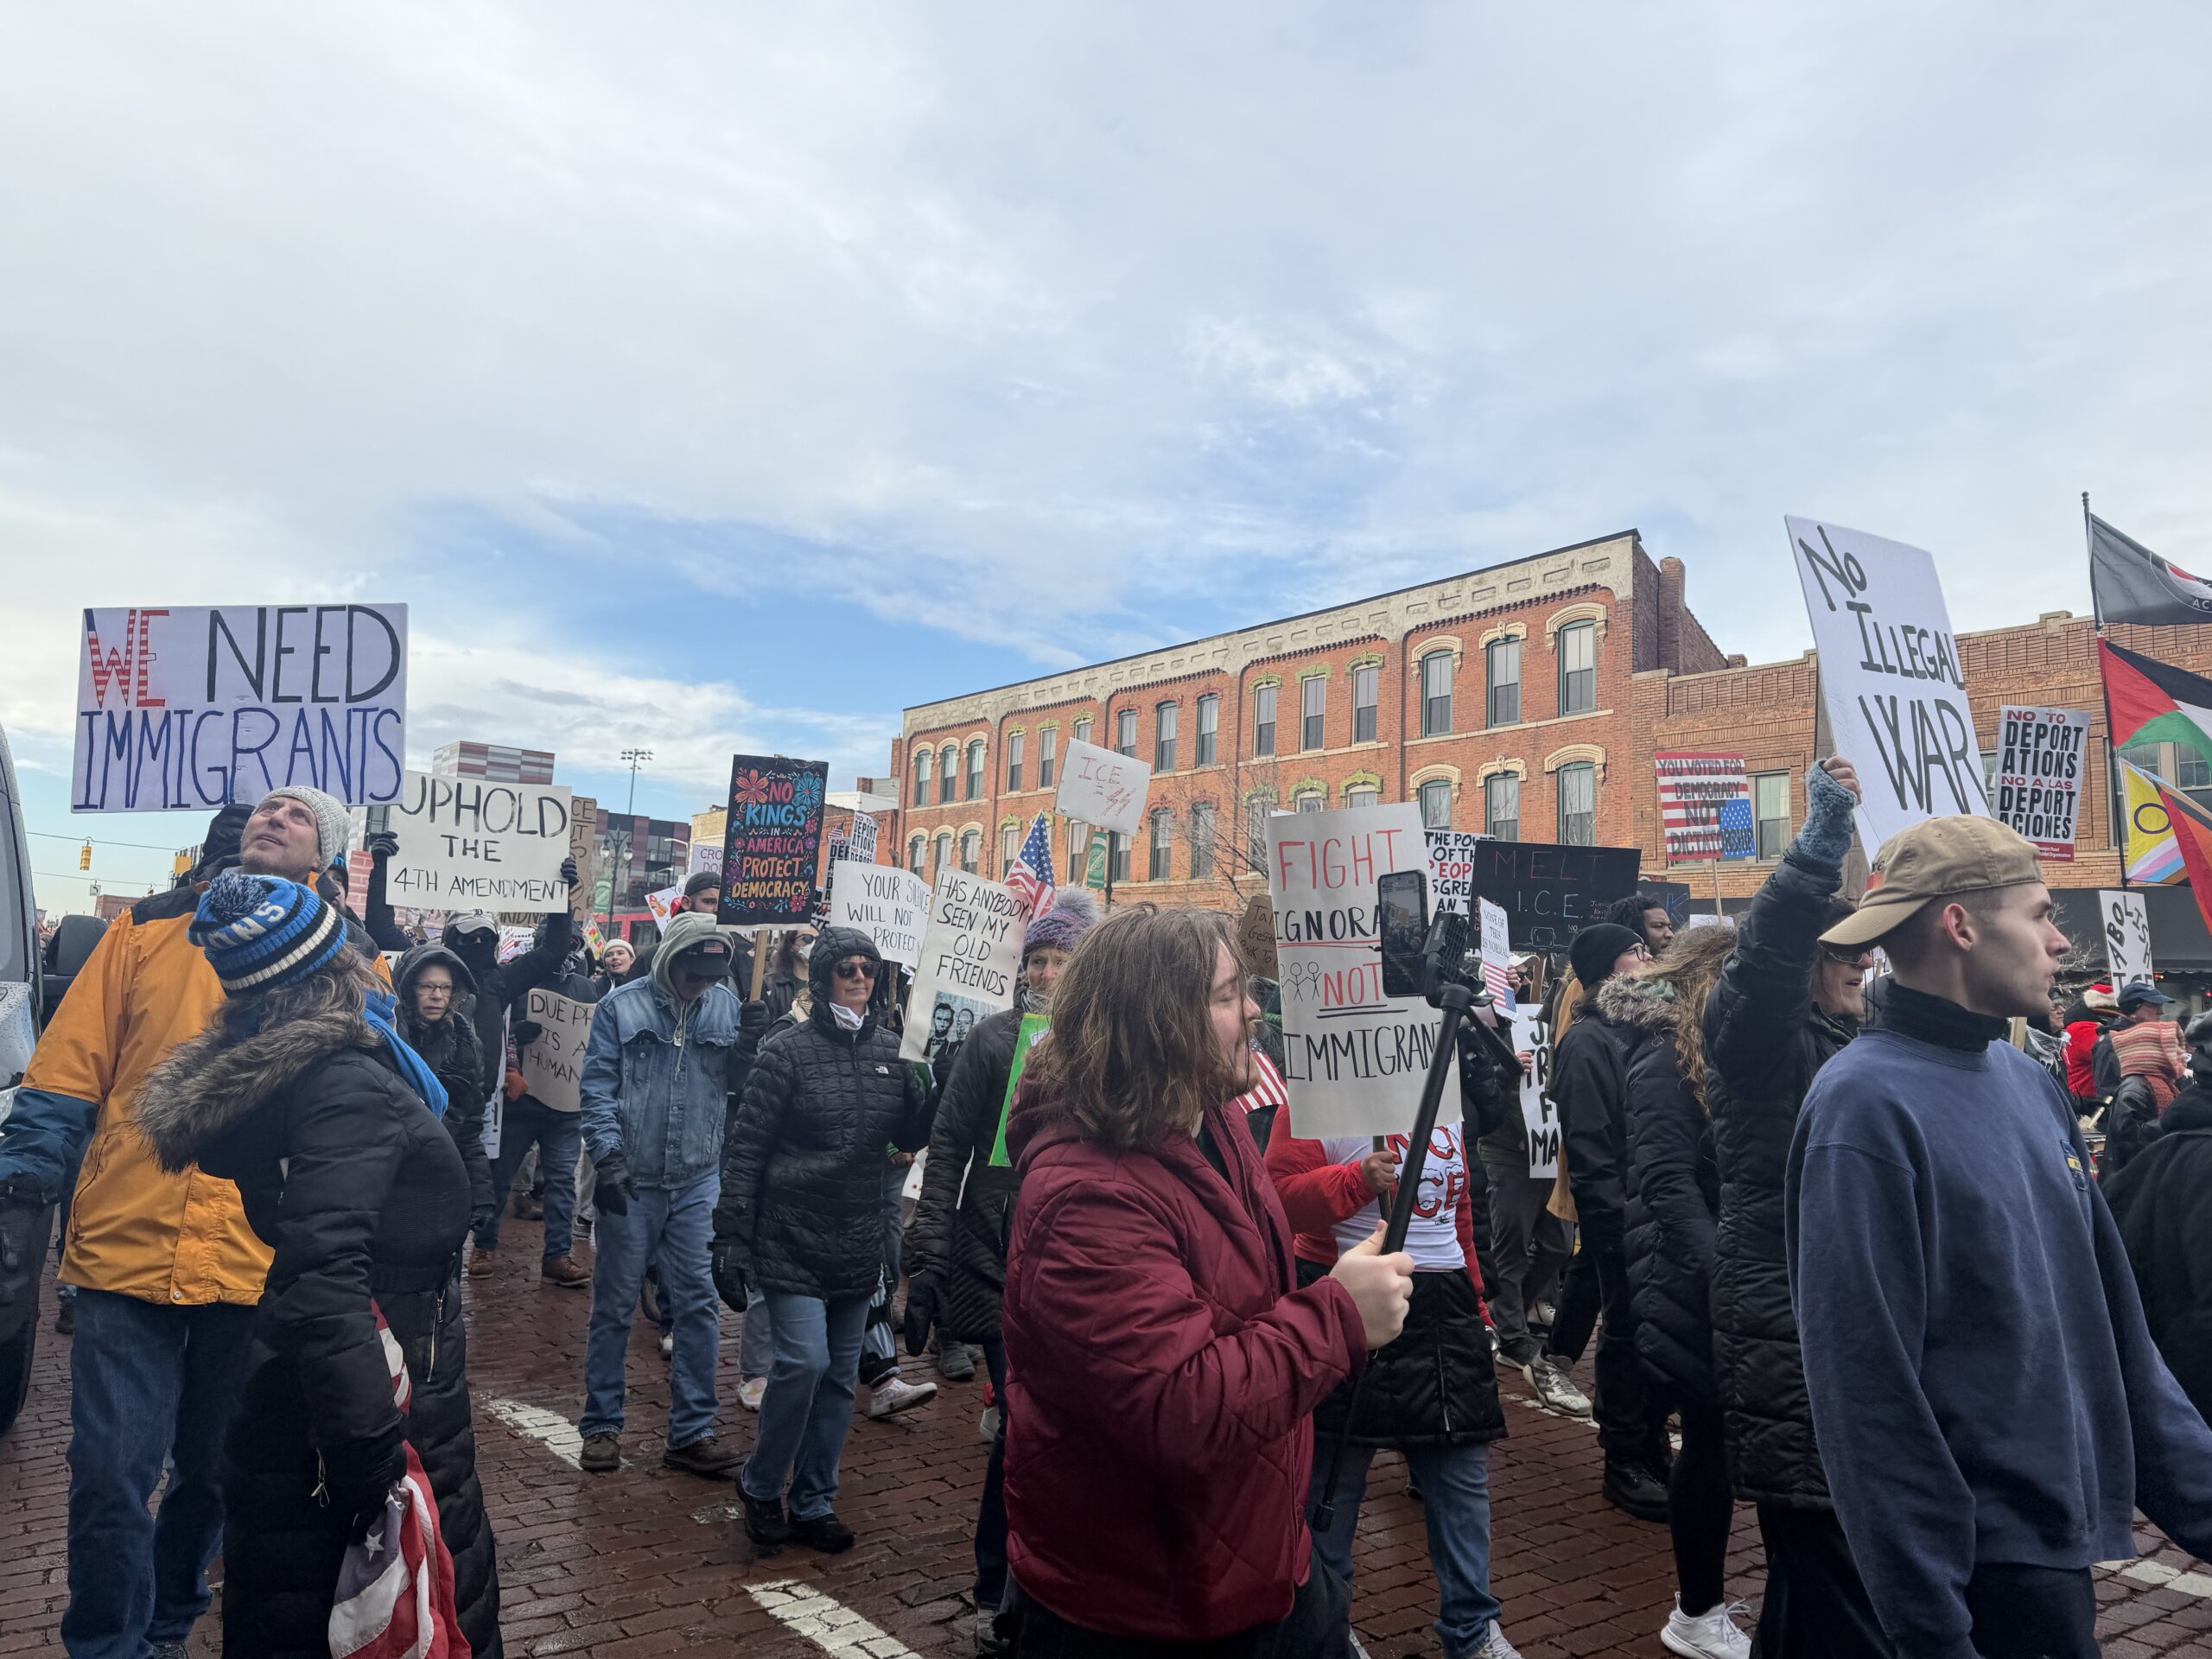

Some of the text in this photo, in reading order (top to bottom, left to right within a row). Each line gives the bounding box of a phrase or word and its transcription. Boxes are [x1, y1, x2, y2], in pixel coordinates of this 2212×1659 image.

[84, 605, 400, 709] WE NEED
[1846, 601, 1966, 690] ILLEGAL
[2006, 710, 2066, 724] NO TO
[2005, 721, 2083, 753] DEPORT
[73, 707, 401, 810] IMMIGRANTS
[1658, 759, 1742, 776] YOU VOTED FOR
[1858, 695, 1993, 815] WAR
[2002, 747, 2078, 779] ATIONS
[1078, 756, 1122, 784] ICE
[2001, 775, 2073, 790] NO A LAS
[767, 781, 794, 804] NO
[1675, 781, 1740, 800] DEMOCRACY
[1999, 785, 2075, 817] DEPORT
[571, 799, 593, 820] CE
[745, 804, 808, 827] KINGS
[1684, 799, 1726, 827] NOT
[1999, 812, 2072, 839] ACIONES
[441, 835, 502, 862] THE
[747, 836, 804, 855] AMERICA
[1424, 831, 1451, 848] THE
[1670, 828, 1754, 856] DICTATORSHIP
[741, 856, 804, 878] PROTECT
[1278, 830, 1402, 892] FIGHT
[1433, 847, 1456, 861] OF
[1495, 850, 1605, 883] MELT
[394, 868, 568, 902] 4TH AMENDMENT
[732, 880, 810, 899] DEMOCRACY
[861, 874, 900, 901] YOUR
[906, 879, 930, 915] SILENCE
[937, 873, 1030, 922] HAS ANYBODY
[848, 902, 886, 923] WILL
[894, 907, 914, 927] NOT
[937, 902, 1010, 943] SEEN MY
[1484, 909, 1497, 925] NONE
[873, 927, 916, 952] PROTECT
[1490, 926, 1502, 940] THIS
[953, 934, 991, 961] OLD
[937, 954, 1008, 996] FRIENDS
[1324, 962, 1382, 1007] NOT
[531, 995, 567, 1022] DUE
[541, 1027, 561, 1050] IS
